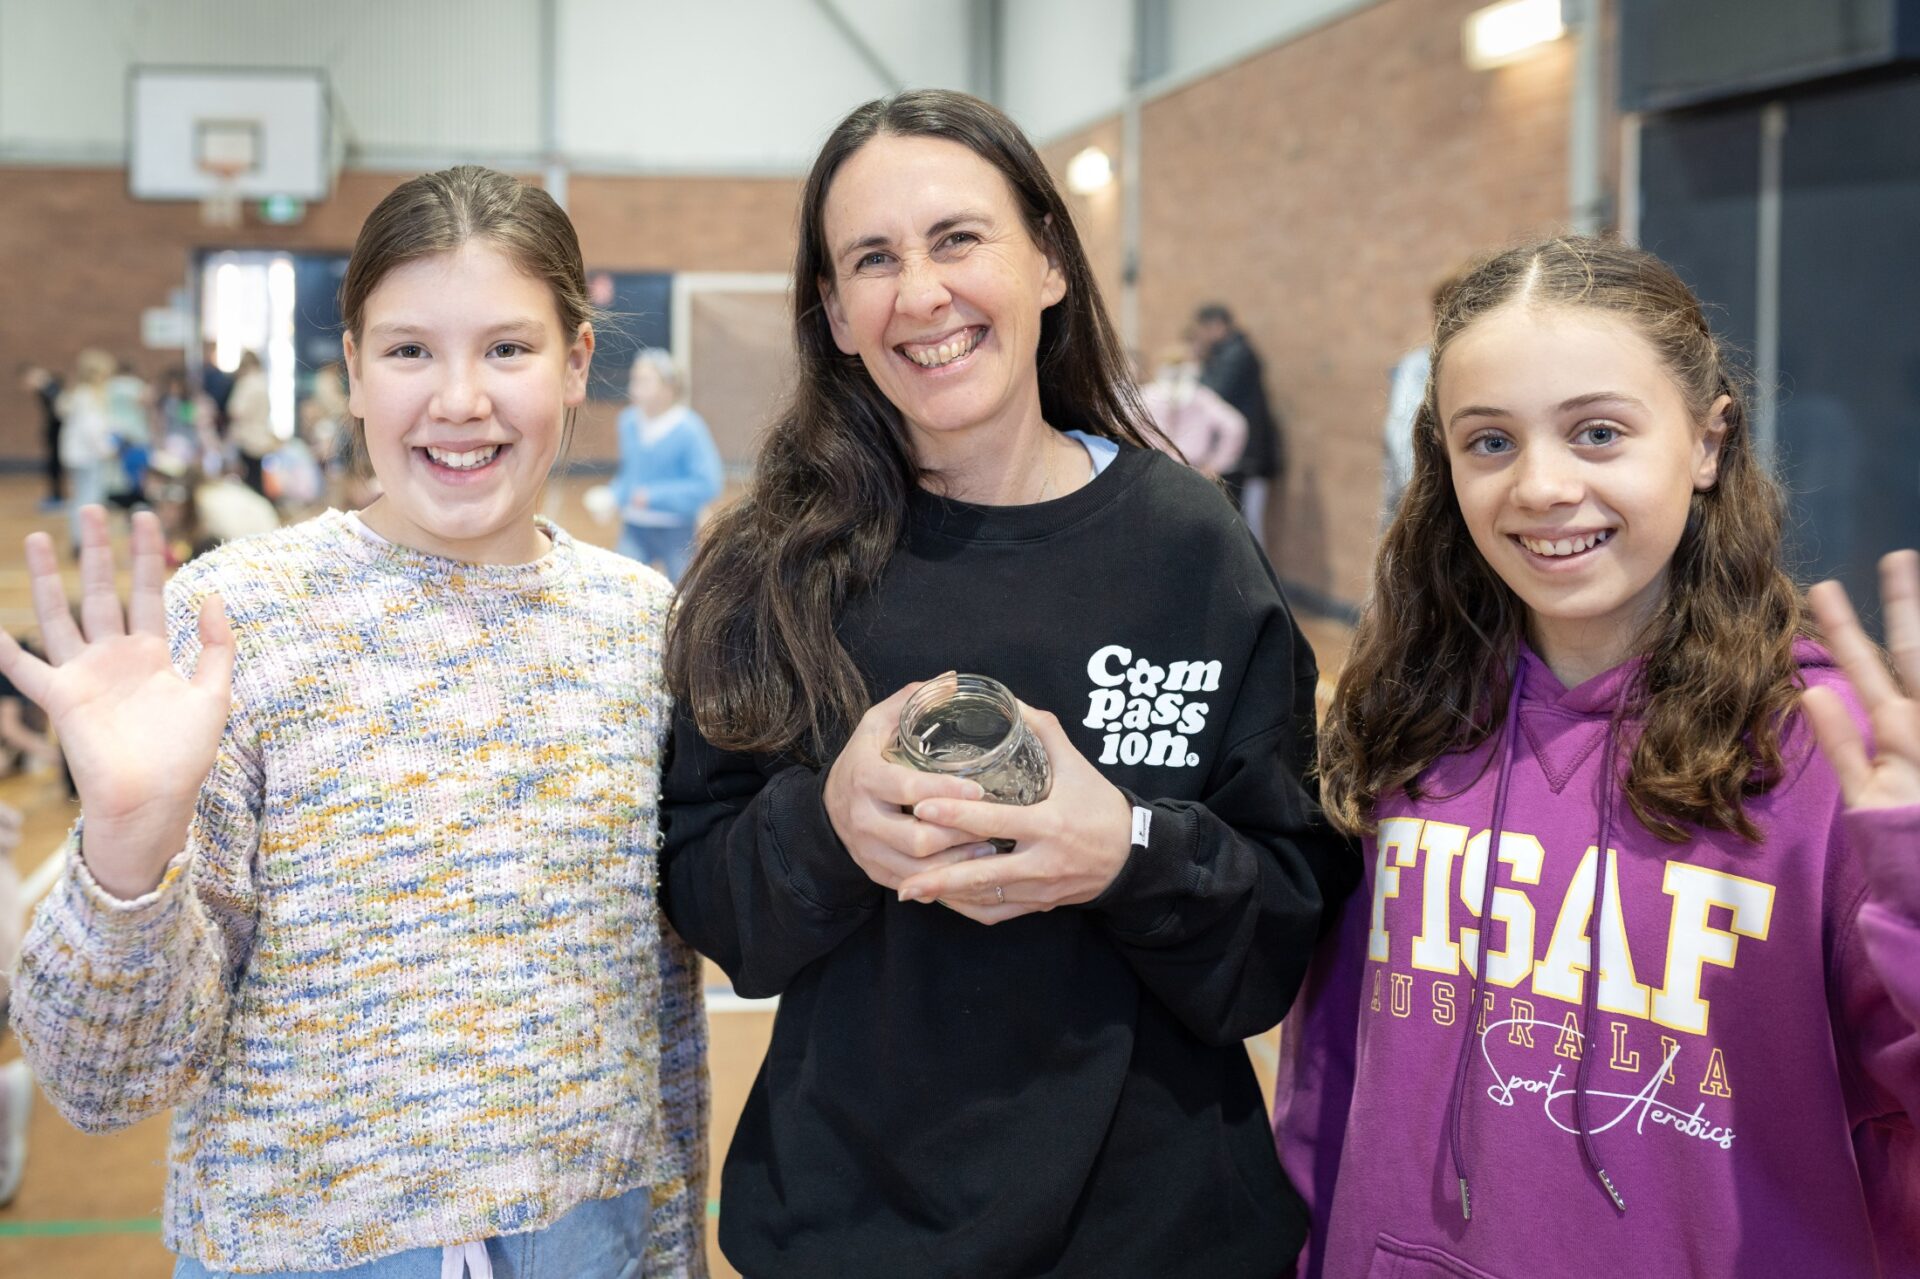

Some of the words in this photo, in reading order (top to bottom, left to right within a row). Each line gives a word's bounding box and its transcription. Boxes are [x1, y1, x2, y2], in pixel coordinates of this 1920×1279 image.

[1082, 688, 1209, 734] pass
[1098, 721, 1200, 768] ion.
[1368, 816, 1776, 1036] FISAF
[1371, 969, 1731, 1098] AUSTRALIA
[1482, 1019, 1596, 1106] Sport
[1545, 1045, 1736, 1149] Aerobics
